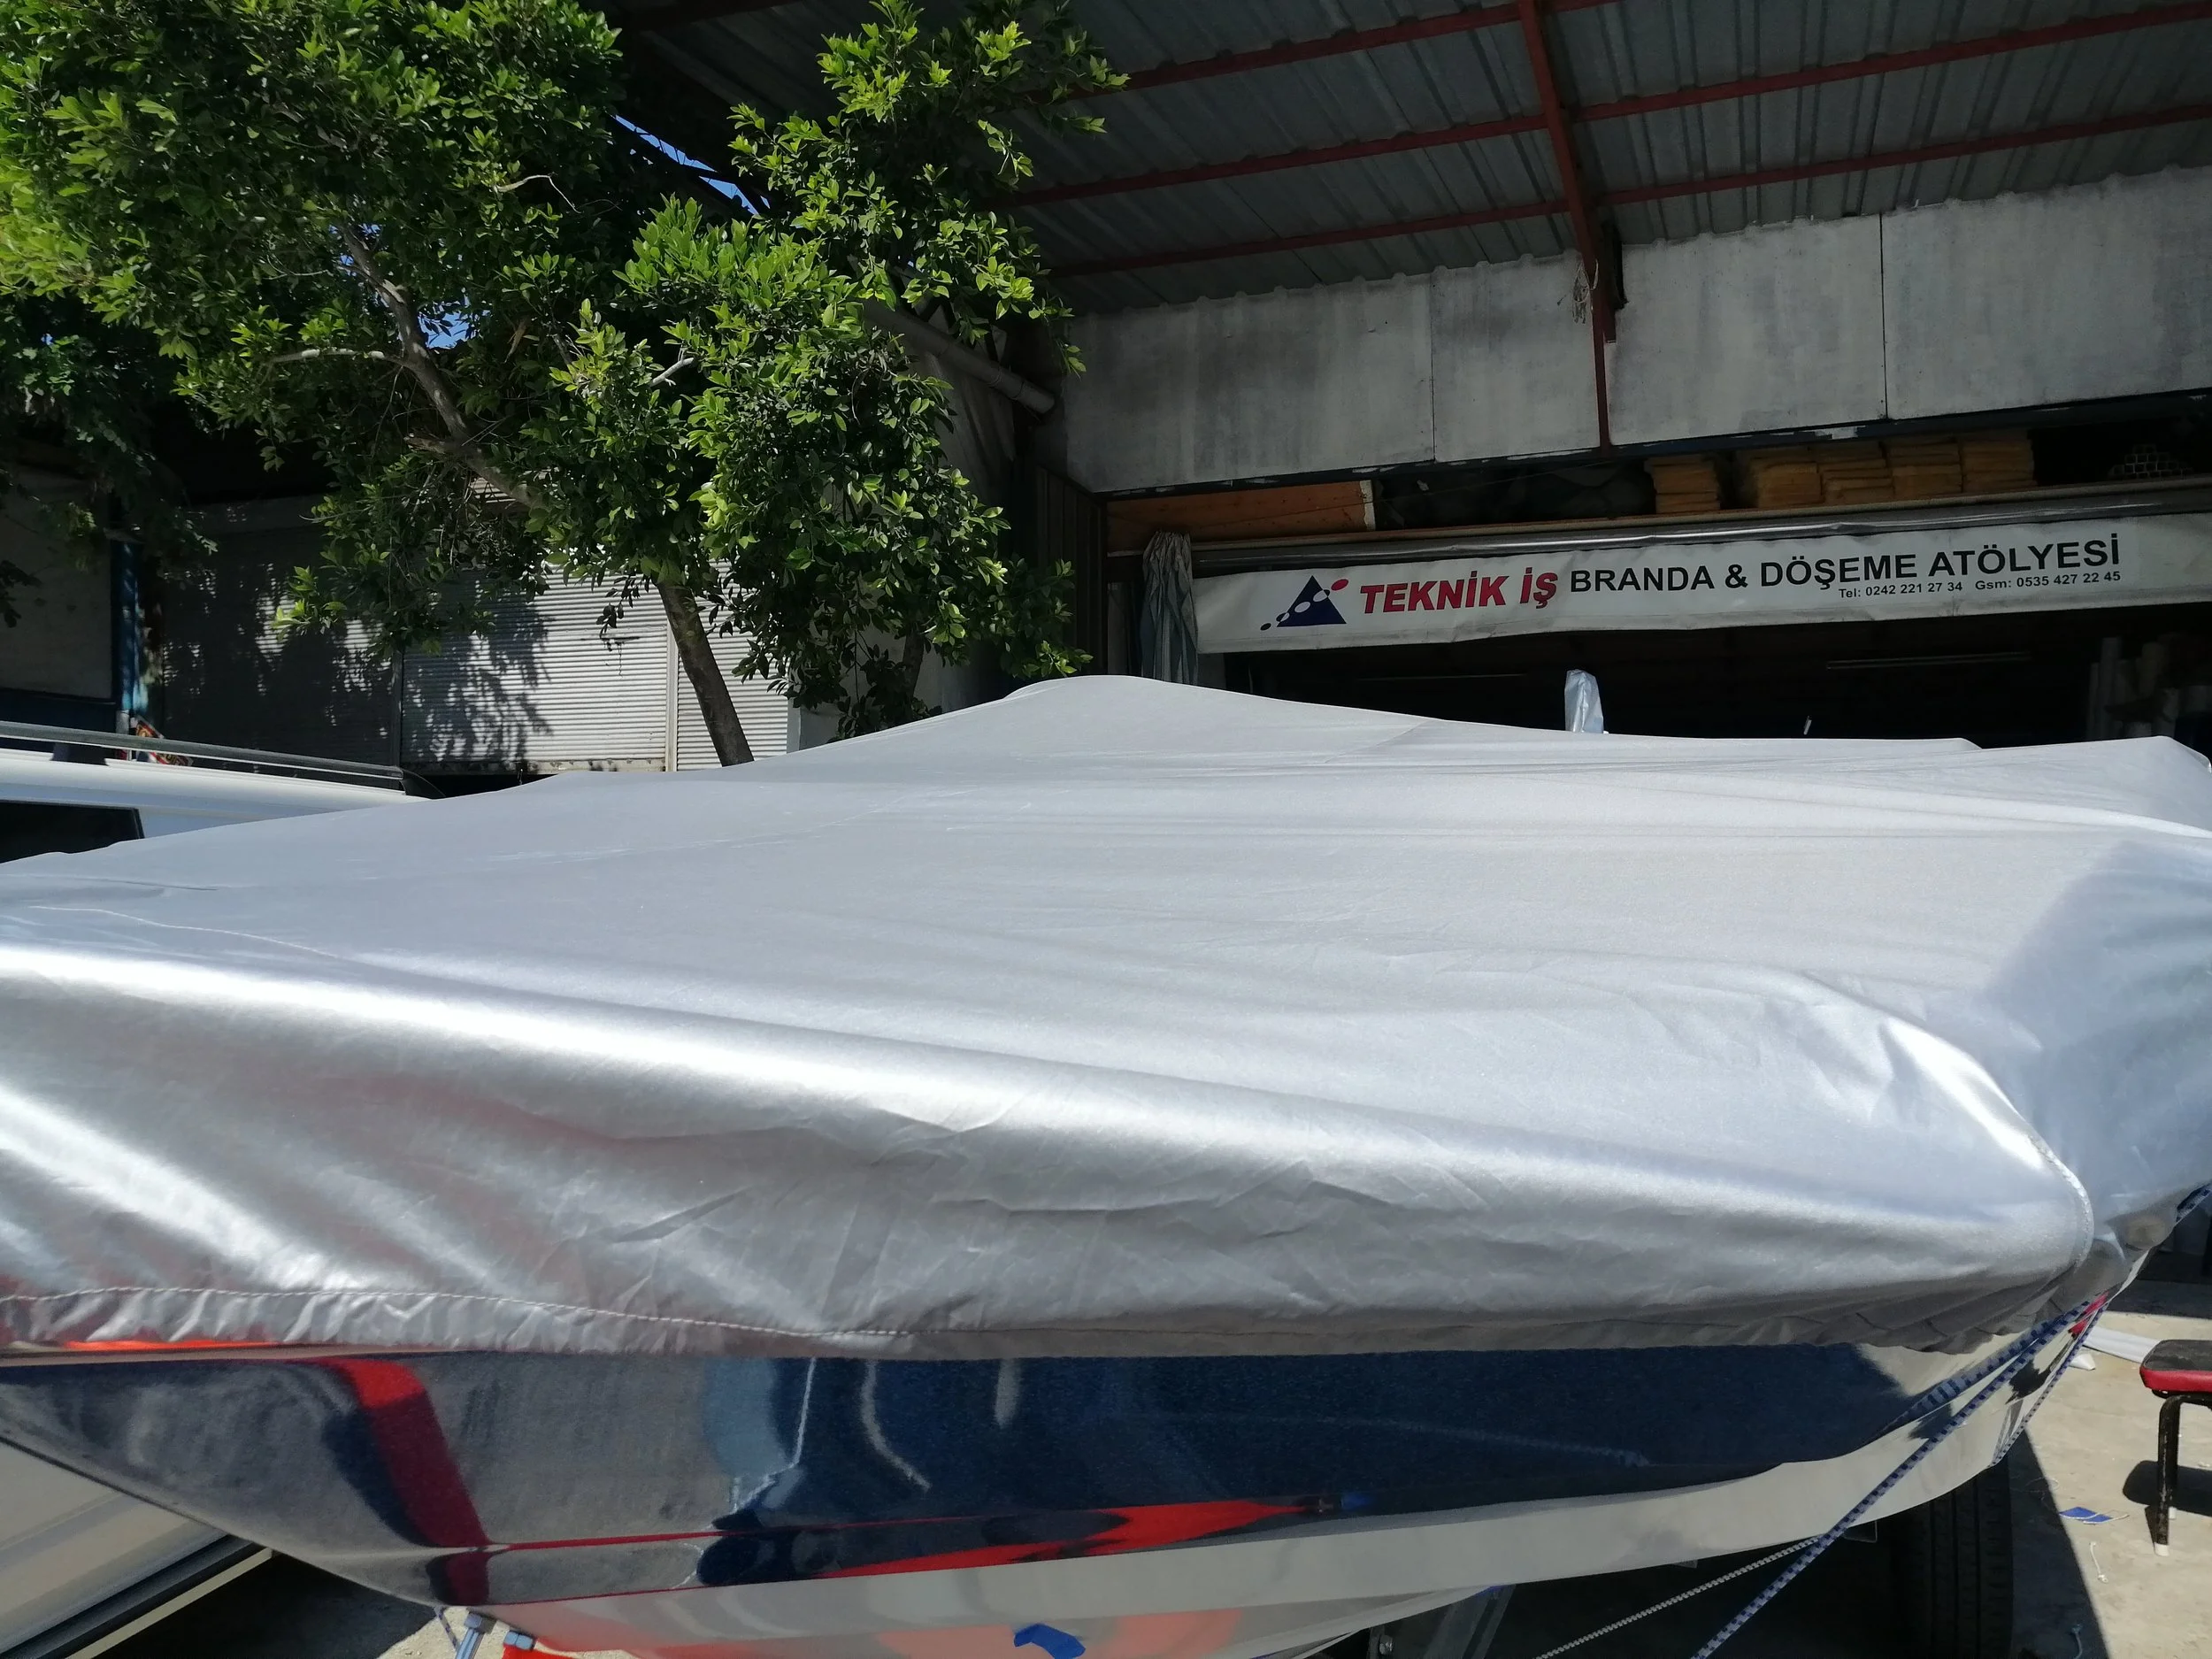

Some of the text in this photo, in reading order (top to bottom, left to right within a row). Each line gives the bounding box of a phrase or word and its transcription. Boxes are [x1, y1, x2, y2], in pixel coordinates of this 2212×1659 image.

[1360, 534, 2119, 614] TEKNİK İŞ BRANDA & DÖŞEME ATÖLYESİ
[1839, 571, 2121, 598] Tel: 0242 221 27 34 Gsm: 0535 427 22 45
